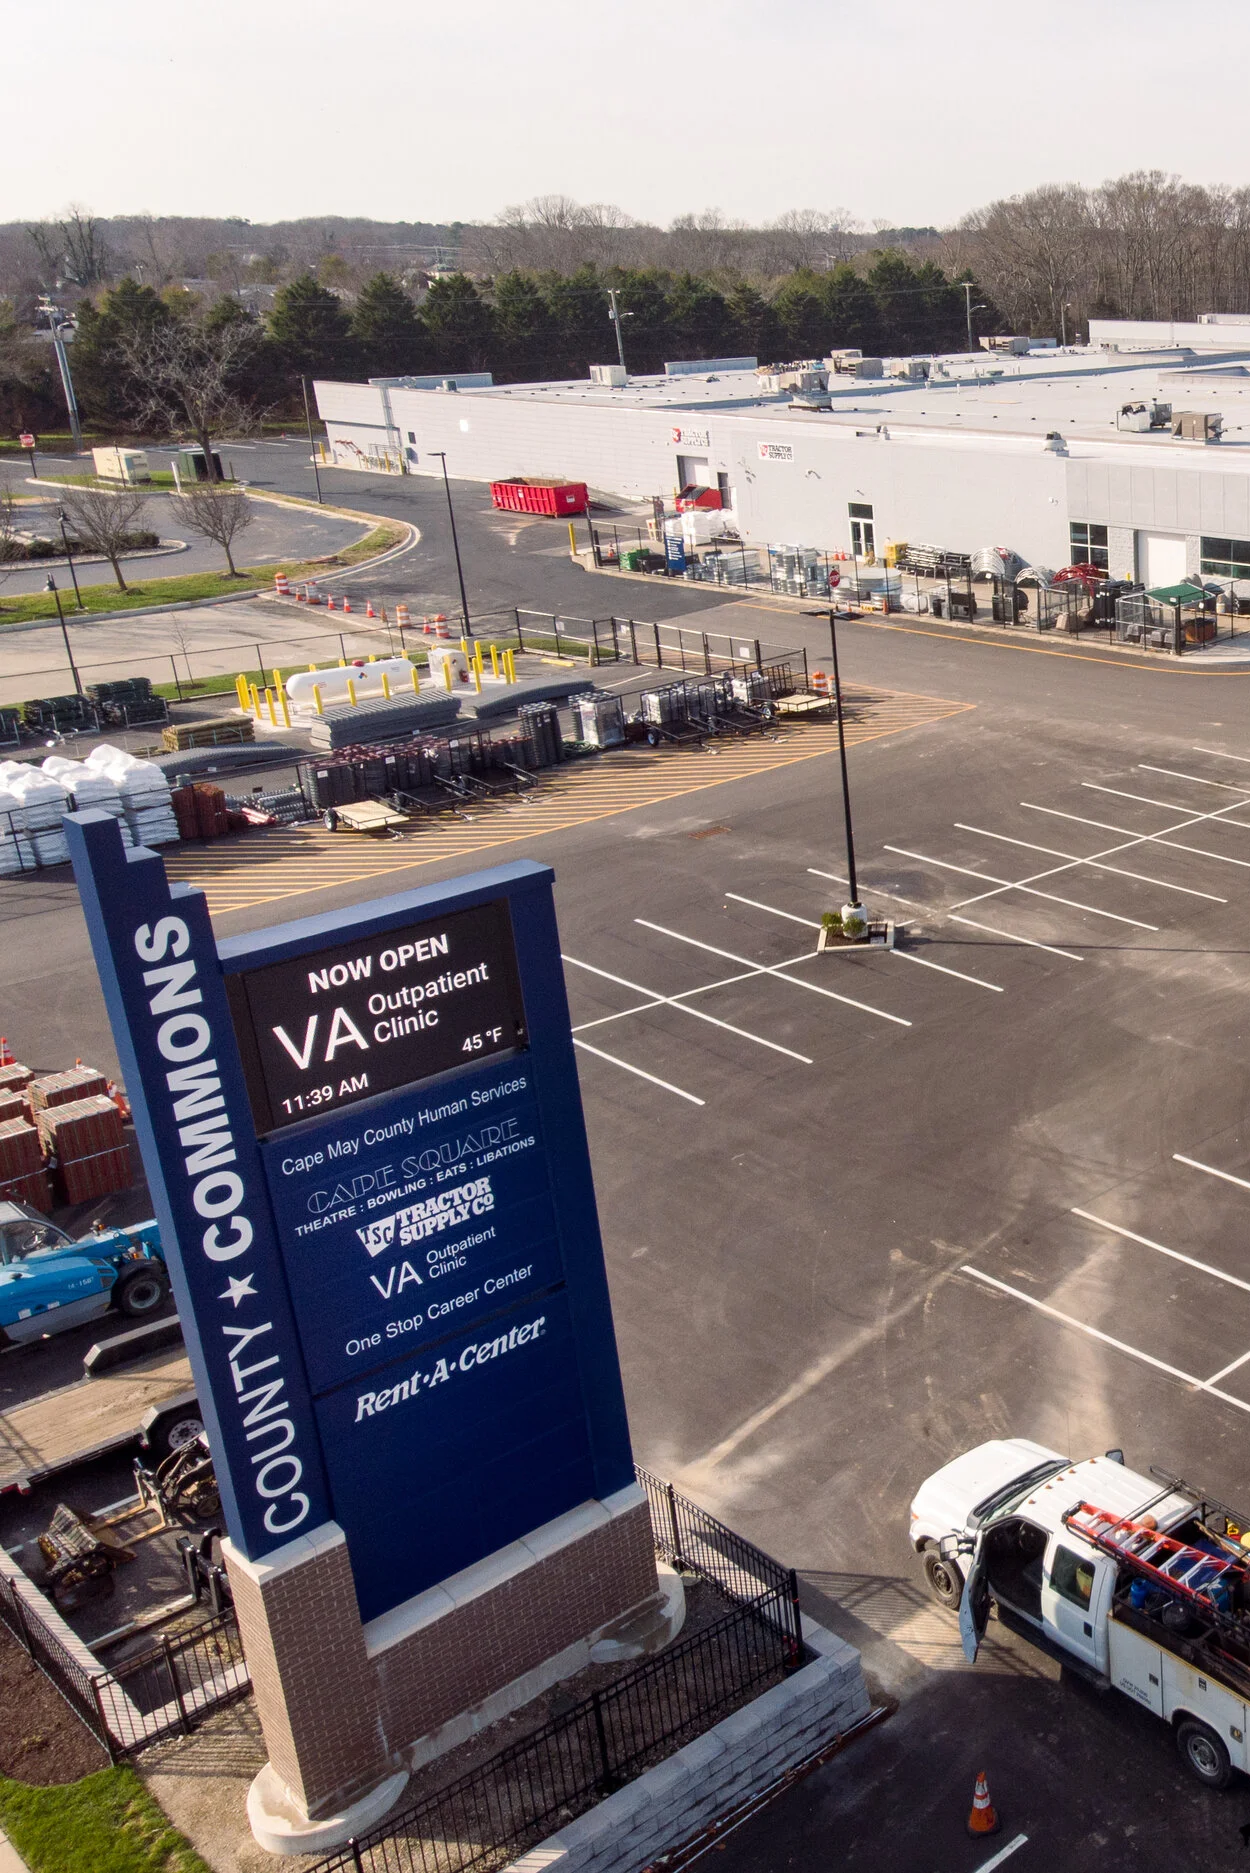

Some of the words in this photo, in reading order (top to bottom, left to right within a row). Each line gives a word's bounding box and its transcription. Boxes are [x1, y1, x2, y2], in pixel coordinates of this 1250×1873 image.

[768, 444, 792, 453] TRACTOR
[769, 452, 786, 460] SUPPLY
[308, 956, 372, 993] NOW
[379, 933, 449, 972] OPEN
[368, 962, 489, 1015] Outpatient
[272, 1007, 370, 1070] VA
[373, 1009, 439, 1043] Clinic
[461, 1033, 483, 1052] 45
[134, 916, 253, 1261] COMMONS
[282, 1085, 333, 1114] 11:39
[338, 1073, 369, 1097] AM
[282, 1151, 324, 1175] Cape
[327, 1138, 359, 1159] May
[364, 1117, 414, 1146] County
[418, 1098, 468, 1126] Human
[471, 1077, 527, 1107] Services
[295, 1205, 357, 1237] THEATRE
[367, 1179, 427, 1210] BOWLING
[436, 1163, 467, 1182] EATS
[476, 1136, 536, 1167] LIBATIONS
[307, 1164, 397, 1214] CAPE
[401, 1117, 520, 1179] SQUARE
[395, 1176, 492, 1228] TRACTOR
[399, 1201, 471, 1247] SUPPLY
[360, 1224, 394, 1246] TSC
[426, 1226, 496, 1264] Outpatient
[369, 1260, 424, 1300] VA
[428, 1255, 467, 1279] Clinic
[345, 1333, 382, 1356] One
[385, 1314, 423, 1339] Stop
[427, 1288, 480, 1320] Career
[484, 1264, 533, 1295] Center
[221, 1321, 310, 1534] COUNTY
